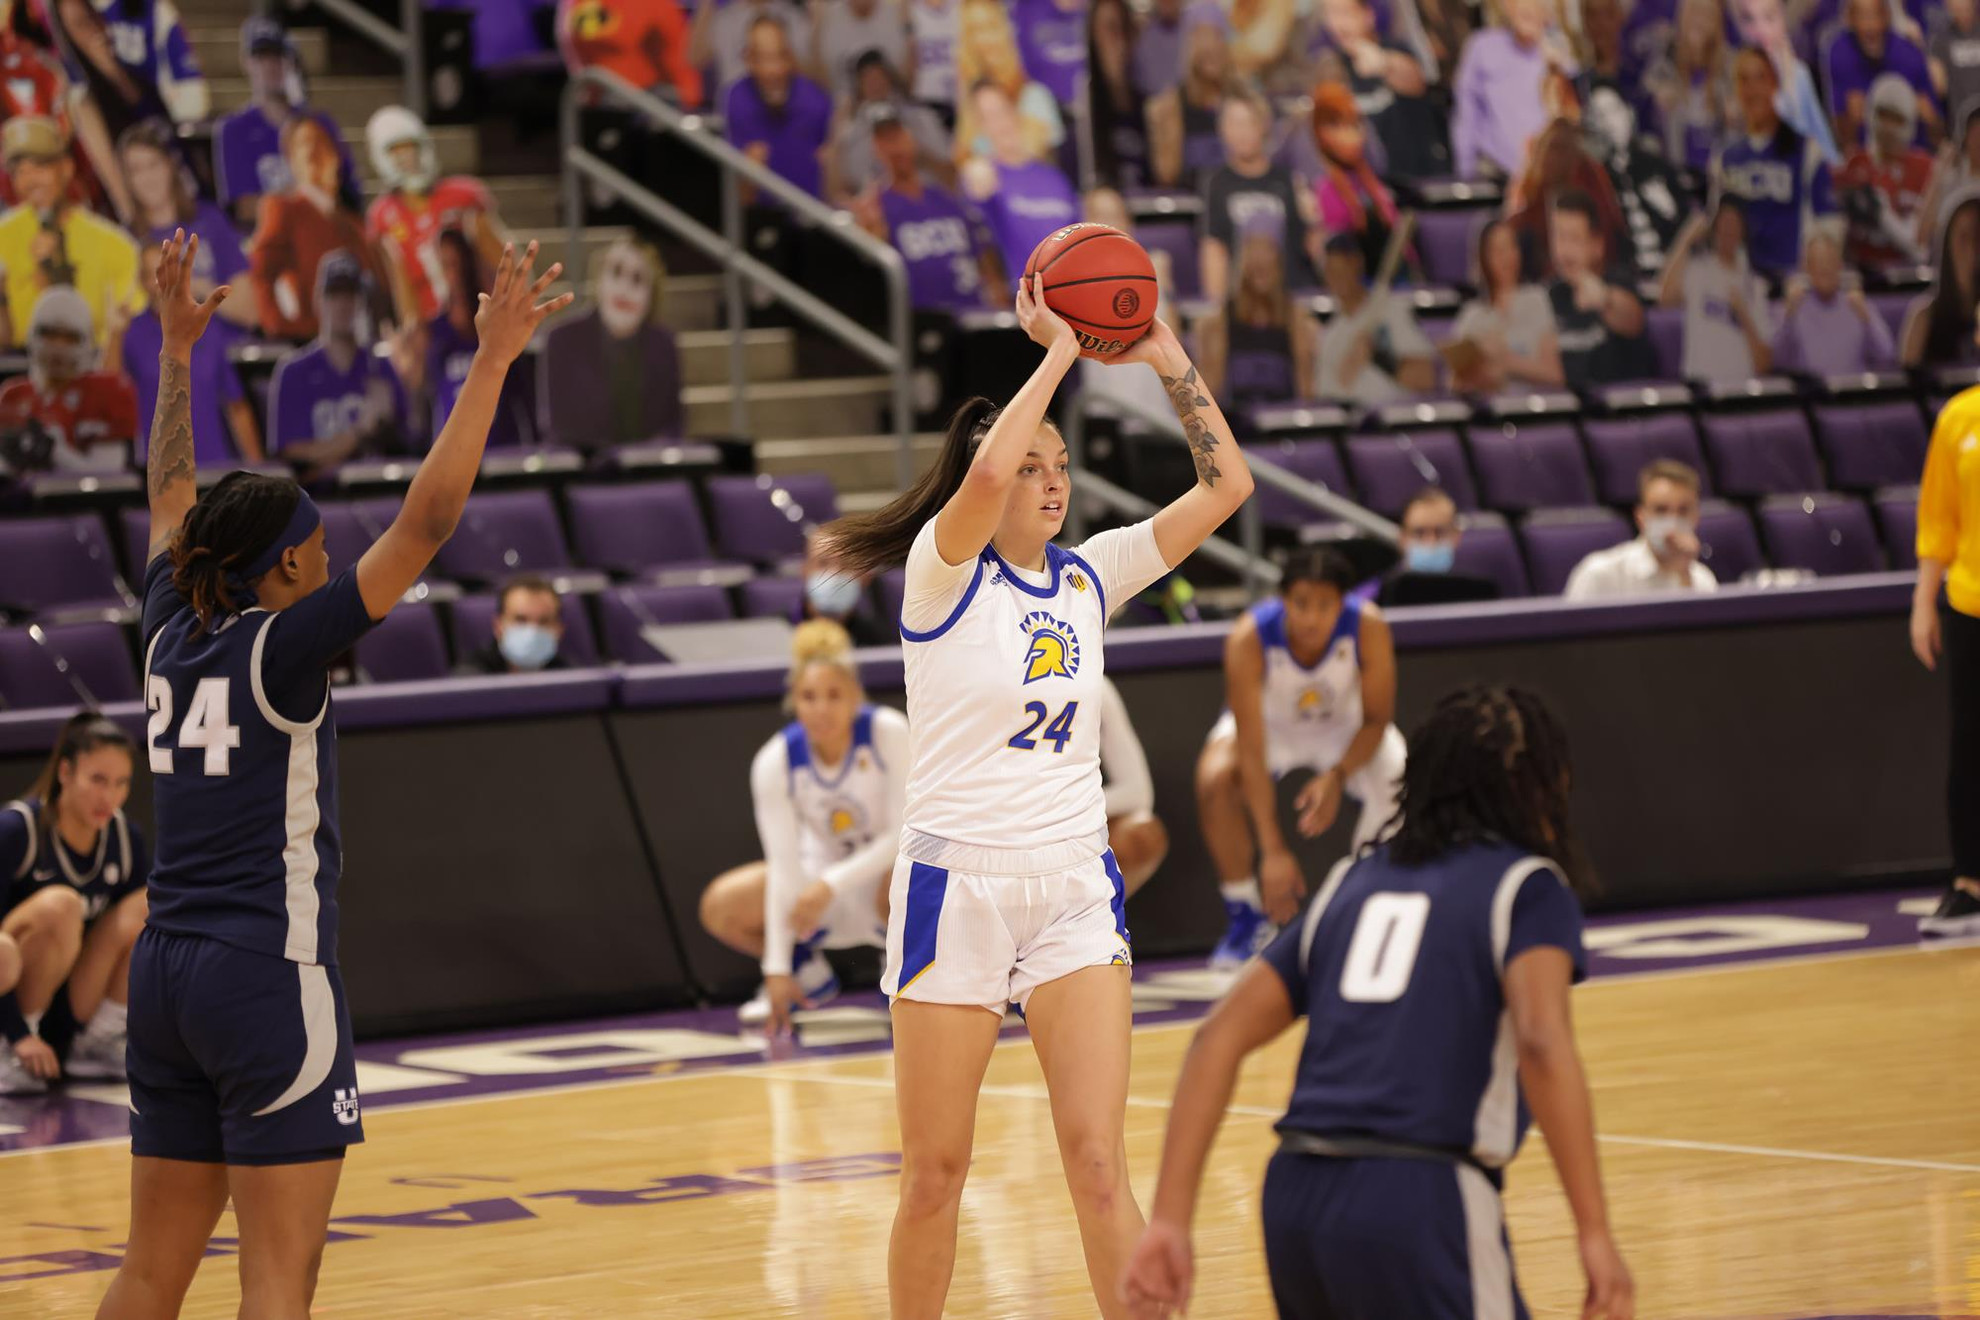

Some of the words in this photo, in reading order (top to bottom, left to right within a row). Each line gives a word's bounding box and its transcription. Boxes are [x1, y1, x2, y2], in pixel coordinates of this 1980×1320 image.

[147, 673, 241, 777] 24
[1007, 699, 1079, 754] 24
[1339, 890, 1431, 1003] 0
